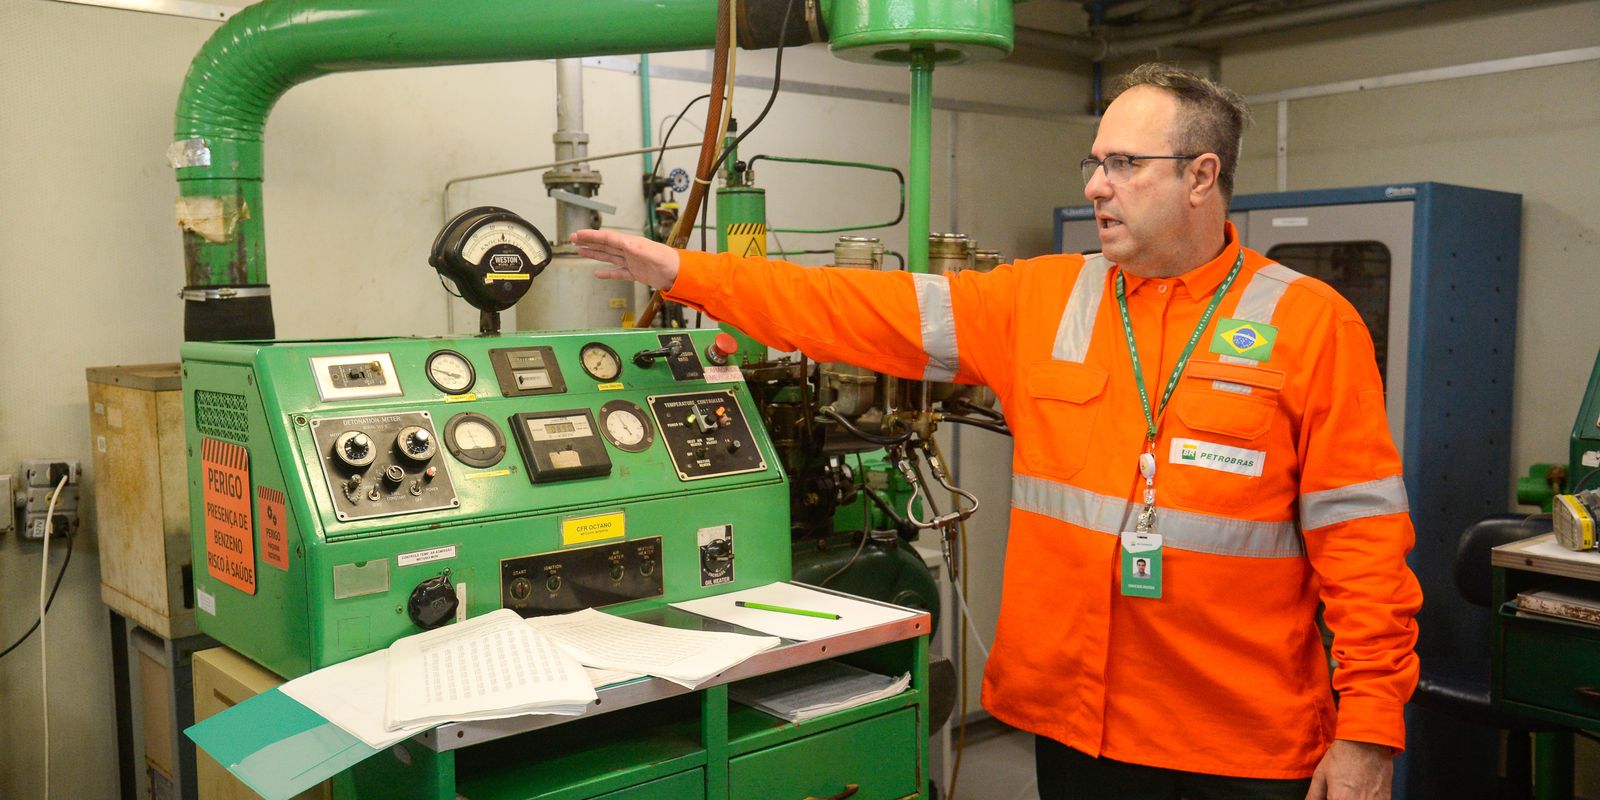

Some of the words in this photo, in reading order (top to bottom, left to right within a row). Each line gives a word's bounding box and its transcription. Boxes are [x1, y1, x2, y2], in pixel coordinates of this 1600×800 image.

[495, 256, 518, 264] WESTON
[664, 400, 695, 408] TEMPERATURE
[343, 417, 380, 426] DETONATION
[381, 415, 401, 423] METER
[1200, 452, 1254, 467] PETROBRAS
[208, 468, 243, 500] PERIGO
[207, 502, 239, 528] PRESENÇA
[239, 513, 248, 530] DE
[589, 522, 612, 530] OCTANO
[213, 529, 243, 554] BENZENO
[265, 528, 281, 542] PERIGO
[207, 551, 224, 572] RISCO
[225, 555, 231, 577] À
[231, 561, 253, 585] SAÚDE
[713, 576, 730, 584] HEATER
